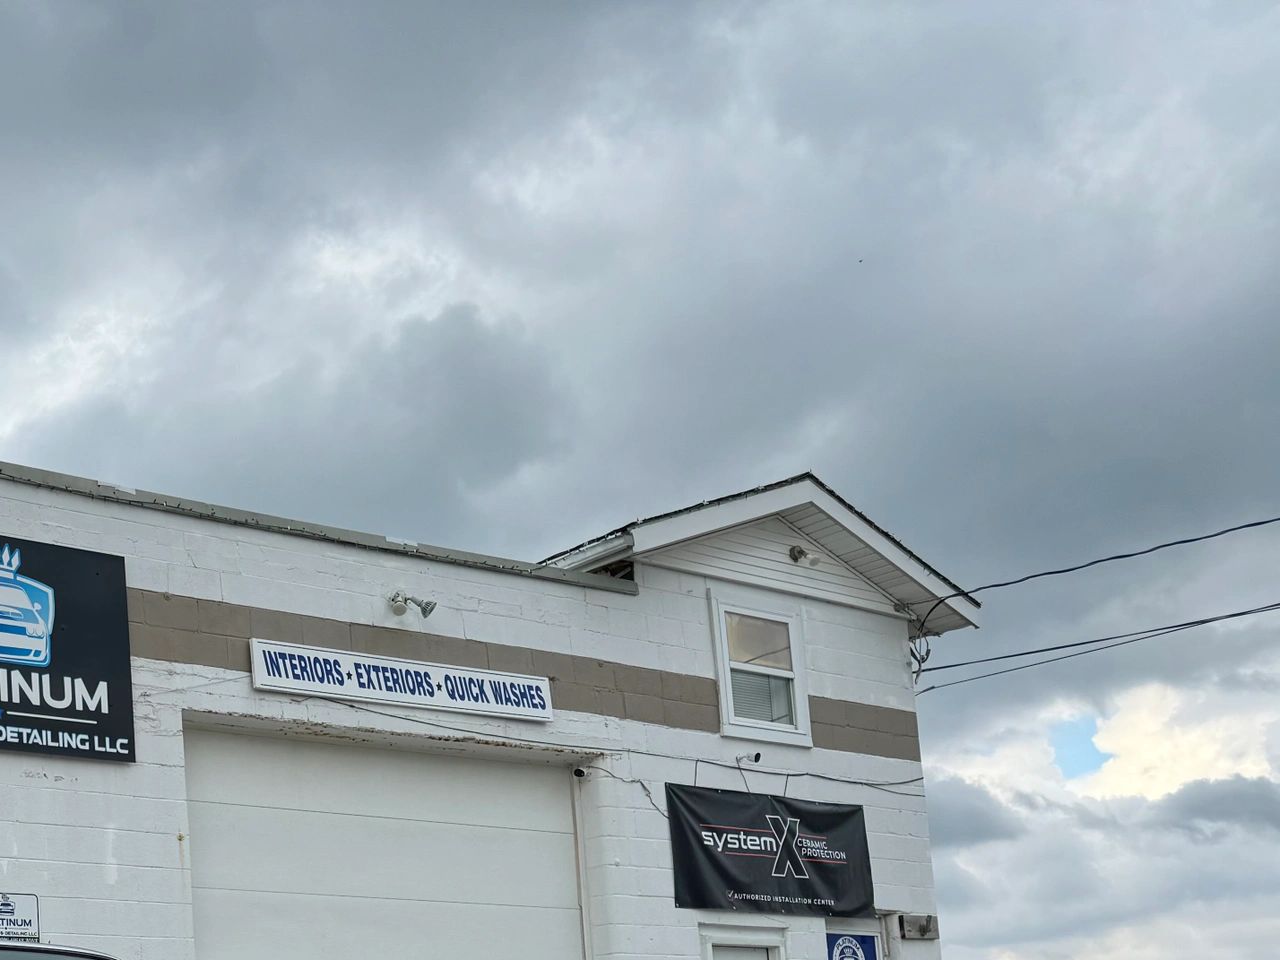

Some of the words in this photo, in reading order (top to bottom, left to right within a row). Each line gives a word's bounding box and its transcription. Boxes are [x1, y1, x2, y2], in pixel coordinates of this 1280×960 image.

[262, 650, 345, 687] INTERIORS
[354, 662, 435, 698] EXTERIORS
[444, 674, 490, 704] QUICK
[489, 680, 546, 711] WASHES
[93, 736, 129, 754] LLC
[797, 838, 828, 849] CERAMIC
[801, 848, 847, 859] PROTECTION
[734, 893, 772, 902] AUTHORIZED
[772, 895, 812, 905] INSTALLATION
[813, 898, 835, 906] CENTER
